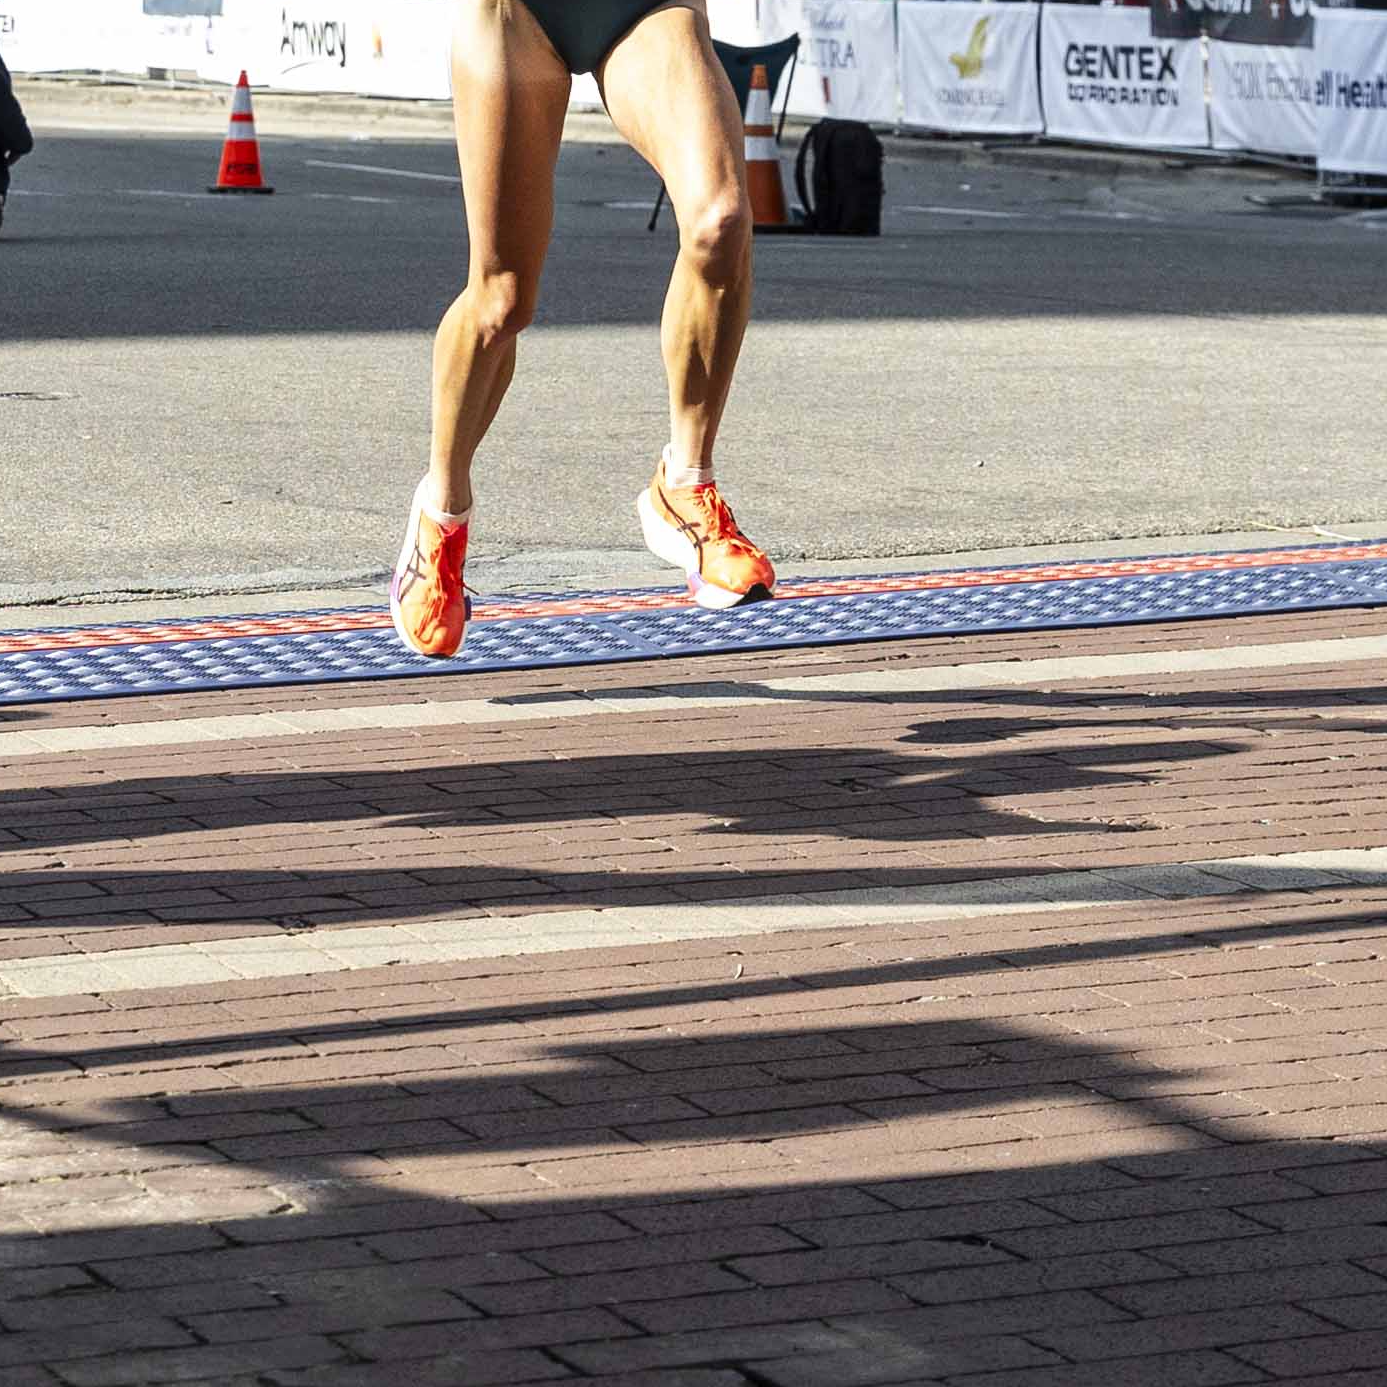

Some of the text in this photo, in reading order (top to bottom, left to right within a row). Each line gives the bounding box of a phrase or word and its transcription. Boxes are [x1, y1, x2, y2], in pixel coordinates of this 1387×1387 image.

[280, 6, 346, 68] Amway
[1064, 42, 1178, 81] GENTEX
[1067, 83, 1180, 107] CORPORATION
